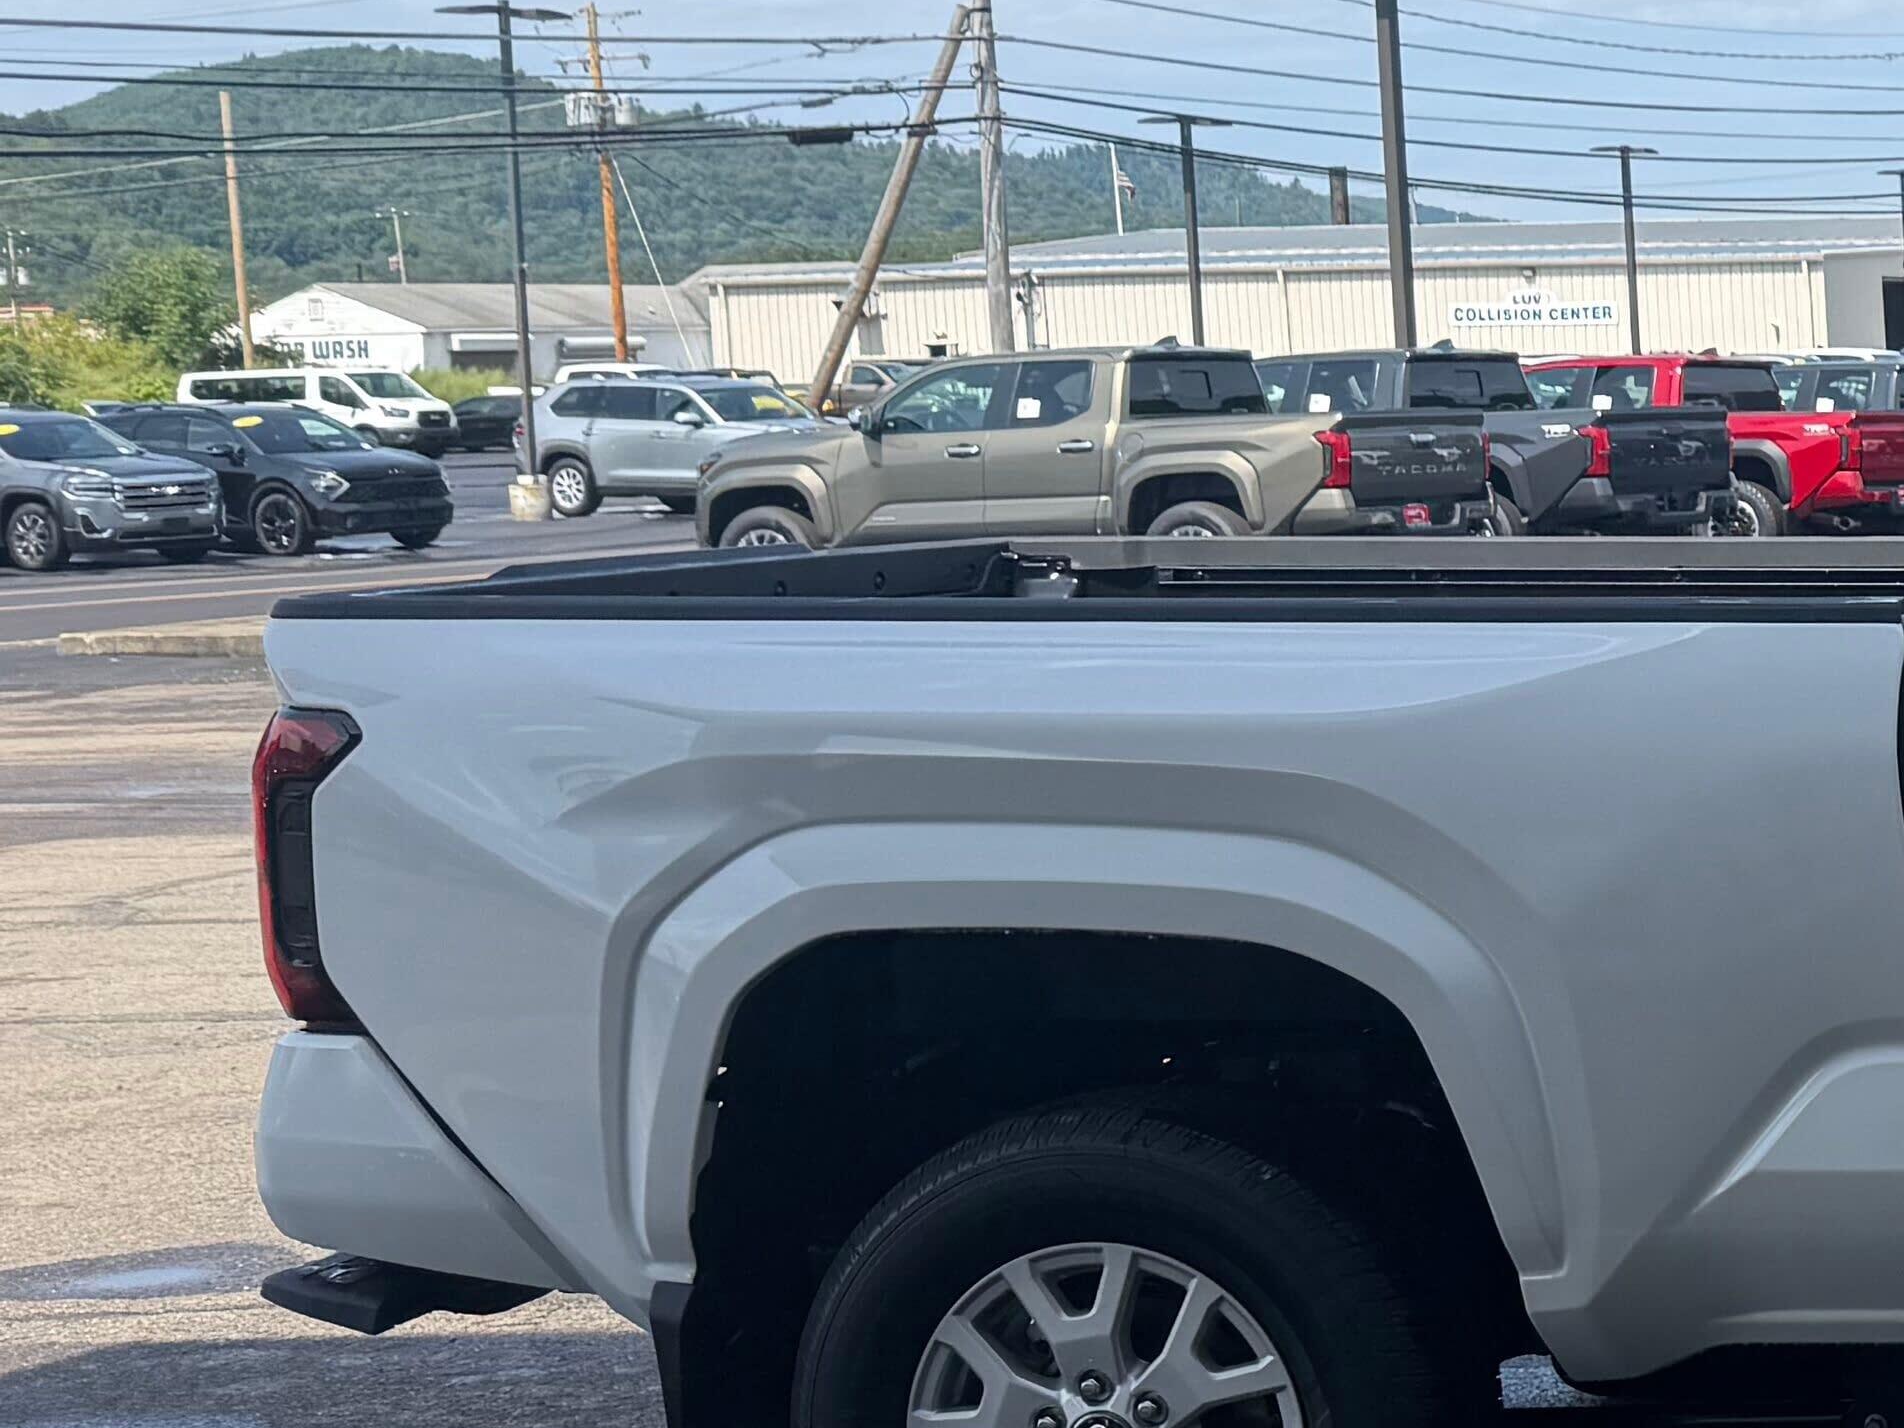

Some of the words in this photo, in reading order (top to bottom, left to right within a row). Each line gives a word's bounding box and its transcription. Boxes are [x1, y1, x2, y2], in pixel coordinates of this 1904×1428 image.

[1454, 307, 1542, 322] COLLISION
[1549, 306, 1612, 320] CENTER
[311, 339, 369, 360] WASH
